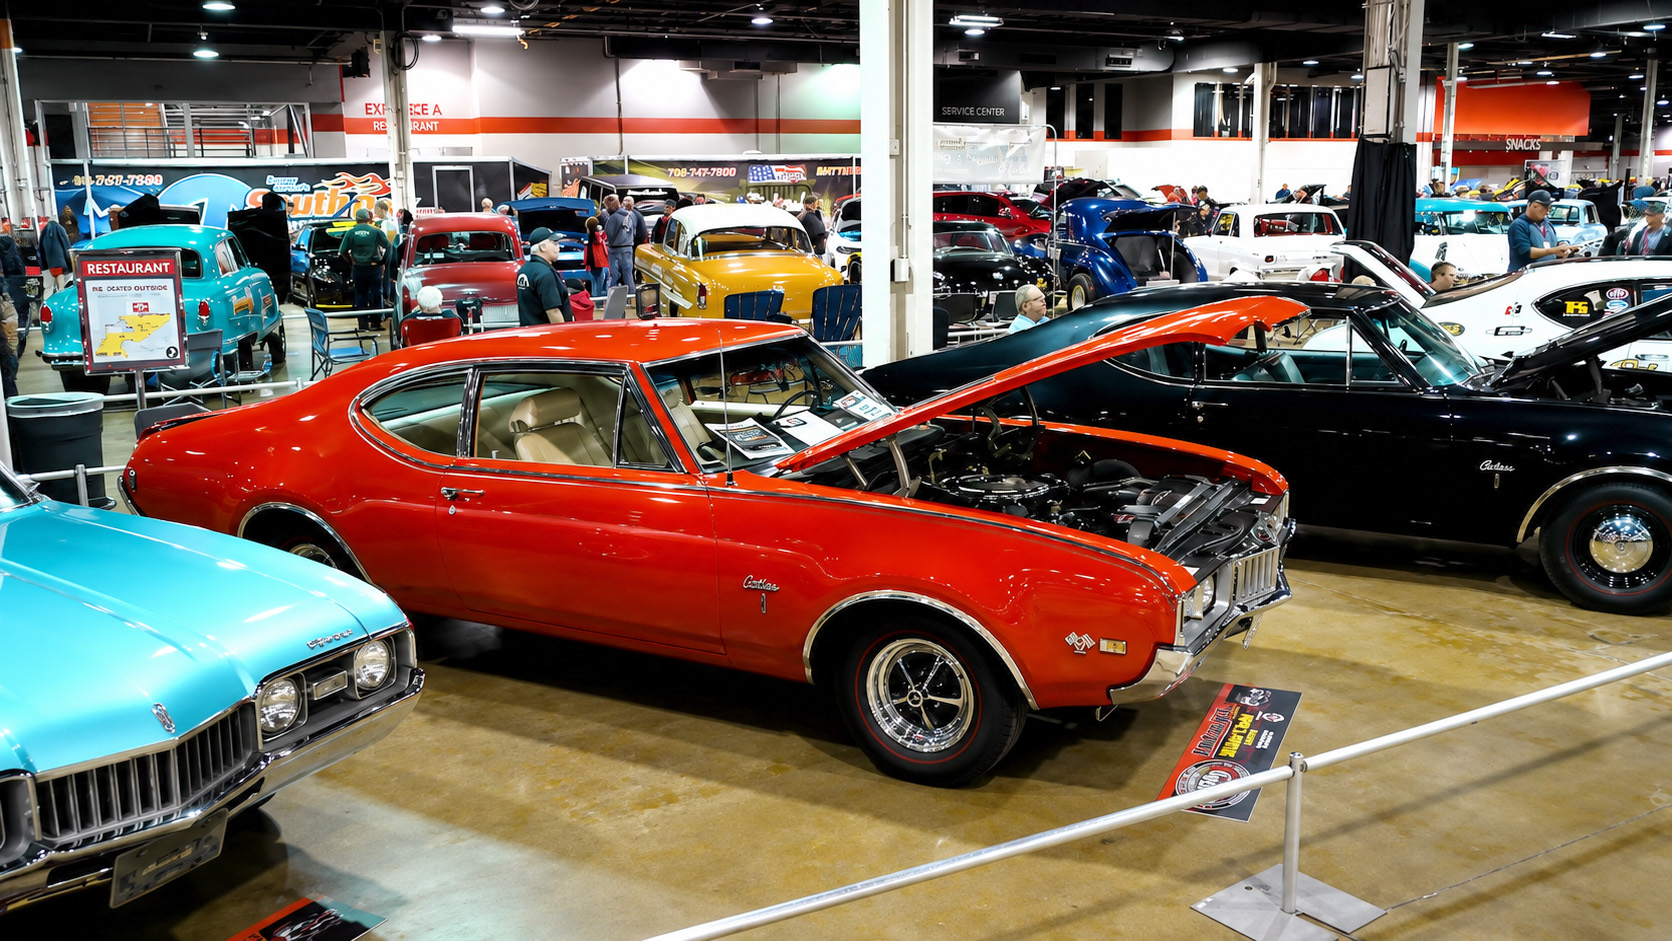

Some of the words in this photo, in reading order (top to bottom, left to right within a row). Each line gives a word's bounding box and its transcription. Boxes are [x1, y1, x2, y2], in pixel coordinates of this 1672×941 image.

[432, 103, 442, 116] A
[942, 107, 975, 116] SERVICE
[976, 107, 1005, 116] CENTER
[1505, 138, 1541, 151] SNACKS
[667, 167, 737, 178] 708-747-7800
[87, 262, 171, 275] RESTAURANT
